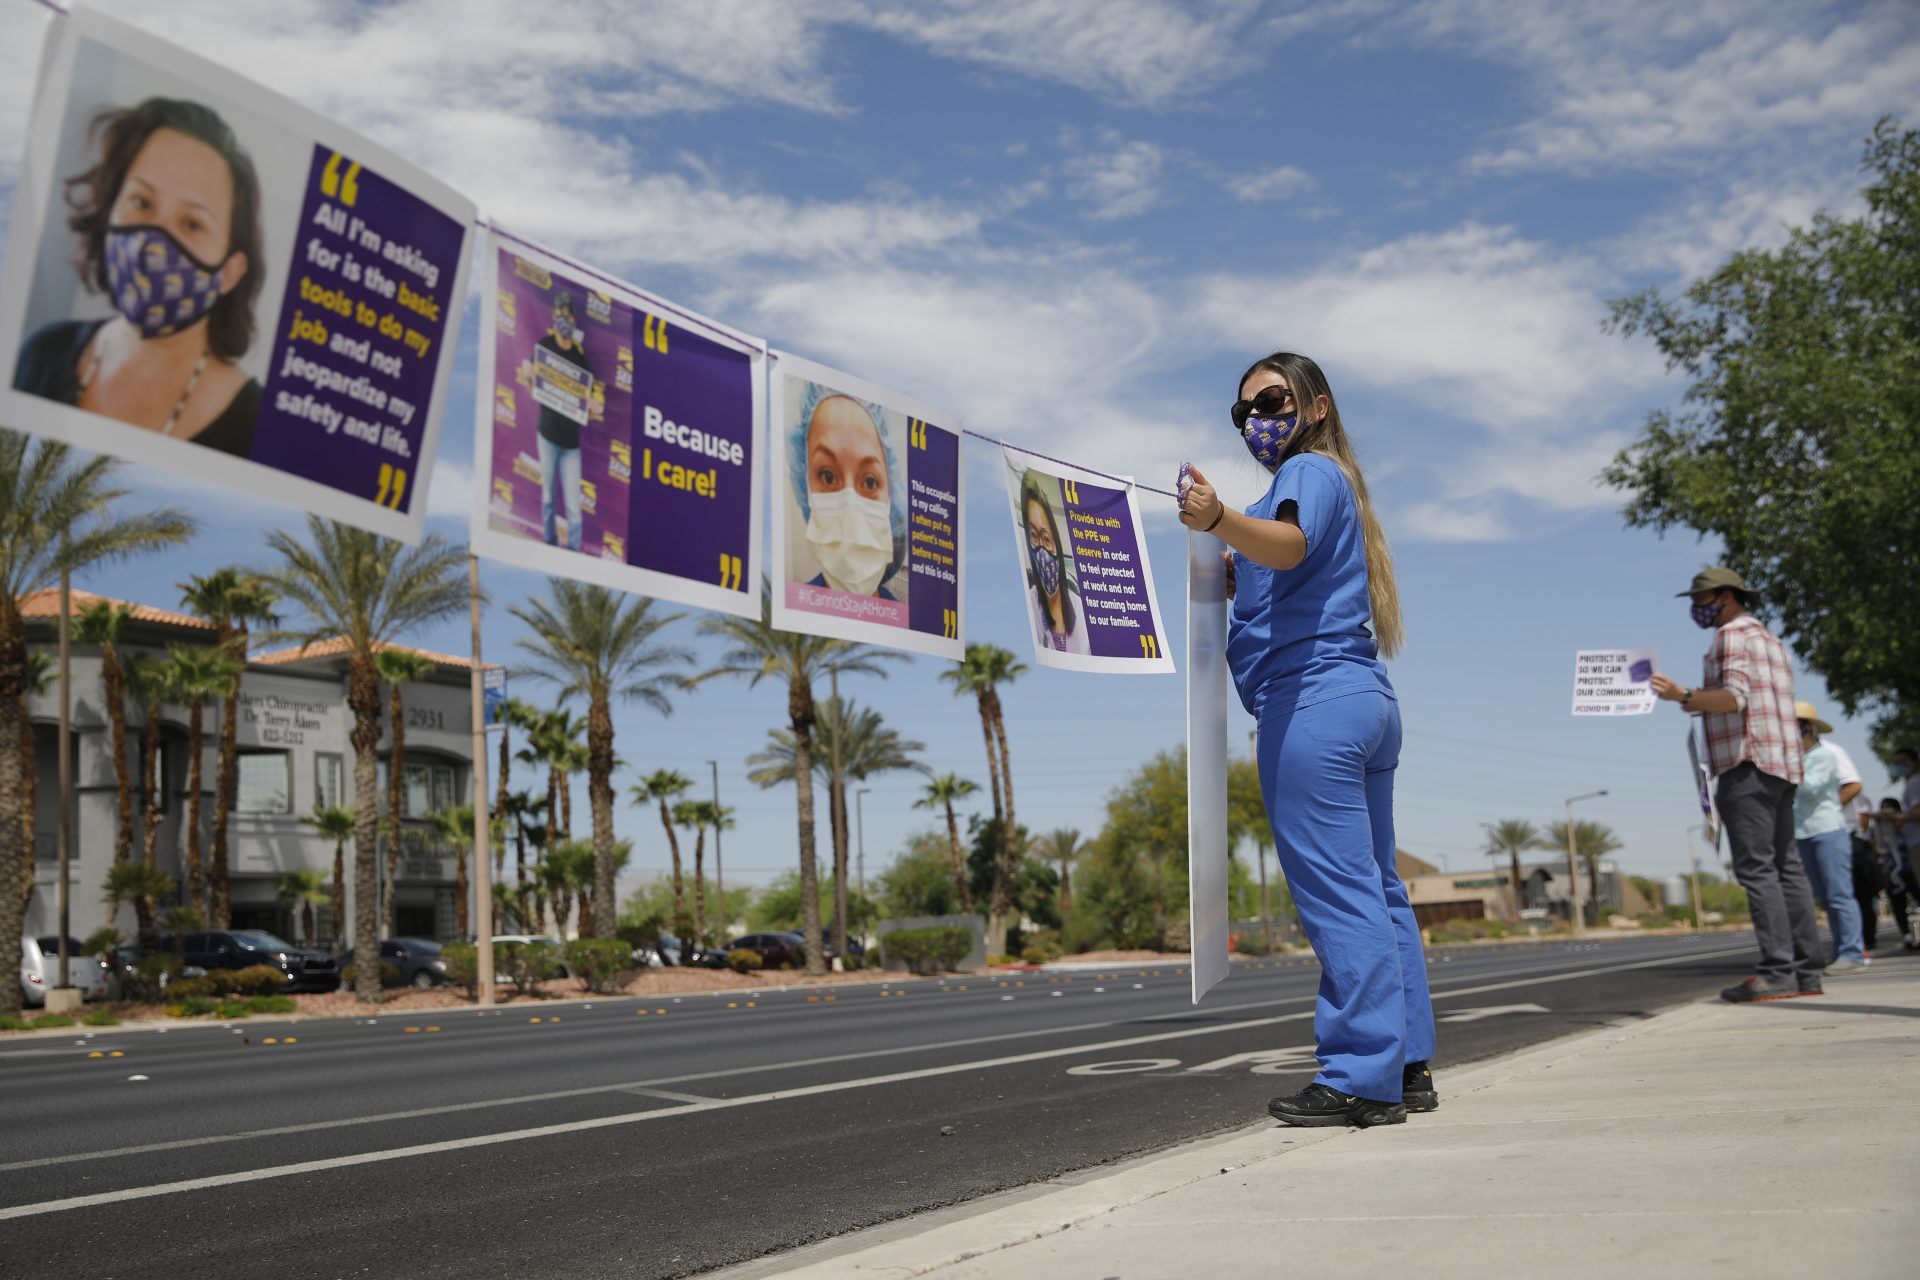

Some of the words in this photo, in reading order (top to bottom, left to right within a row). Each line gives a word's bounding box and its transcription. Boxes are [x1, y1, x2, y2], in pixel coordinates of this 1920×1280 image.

[312, 202, 347, 236] All
[348, 217, 381, 253] I'm
[382, 240, 440, 289] asking
[306, 238, 341, 271] for
[341, 253, 362, 282] is
[363, 265, 396, 299] the
[397, 281, 440, 322] basic
[301, 276, 352, 317] tools
[356, 301, 377, 328] to
[378, 313, 403, 340] do
[403, 328, 430, 358] my
[288, 309, 328, 346] job
[329, 333, 371, 363] and
[370, 351, 402, 379] not
[280, 346, 388, 410] jeopardize
[387, 396, 416, 426] my
[275, 390, 343, 434] safety
[343, 416, 382, 444] and
[380, 425, 411, 458] life.
[644, 405, 744, 466] Because
[643, 448, 652, 480] I
[657, 461, 717, 498] care!
[911, 479, 926, 494] This
[925, 486, 957, 504] occupation
[911, 495, 918, 507] is
[918, 500, 929, 513] my
[915, 514, 932, 528] often
[932, 519, 942, 531] put
[943, 524, 952, 536] my
[1069, 509, 1095, 525] Provide
[1095, 517, 1105, 527] us
[1104, 516, 1121, 529] with
[911, 530, 938, 546] patient's
[938, 538, 955, 551] needs
[1073, 527, 1084, 539] the
[1084, 529, 1099, 541] PPE
[1099, 532, 1111, 543] we
[911, 544, 932, 560] before
[932, 552, 941, 564] my
[942, 555, 954, 566] own
[1076, 545, 1102, 559] deserve
[1102, 548, 1111, 560] in
[1111, 550, 1130, 562] order
[911, 562, 925, 574] and
[924, 565, 936, 577] this
[936, 567, 942, 578] is
[1079, 562, 1087, 573] to
[1087, 561, 1101, 575] feel
[1101, 566, 1136, 579] protected
[1083, 580, 1091, 591] at
[1090, 580, 1109, 593] work
[1108, 583, 1123, 595] and
[1122, 584, 1137, 596] not
[1085, 596, 1100, 609] fear
[1099, 599, 1126, 614] coming
[1126, 600, 1148, 612] home
[1088, 614, 1097, 625] to
[1097, 616, 1109, 627] our
[1109, 615, 1141, 628] families.
[1578, 654, 1614, 663] PROTECT
[1615, 654, 1627, 662] US
[1578, 665, 1589, 674] SO
[1591, 665, 1603, 674] WE
[1604, 665, 1622, 674] CAN
[1577, 676, 1614, 685] PROTECT
[1575, 688, 1594, 697] OUR
[1595, 688, 1647, 697] COMMUNITY
[409, 707, 444, 729] 2931
